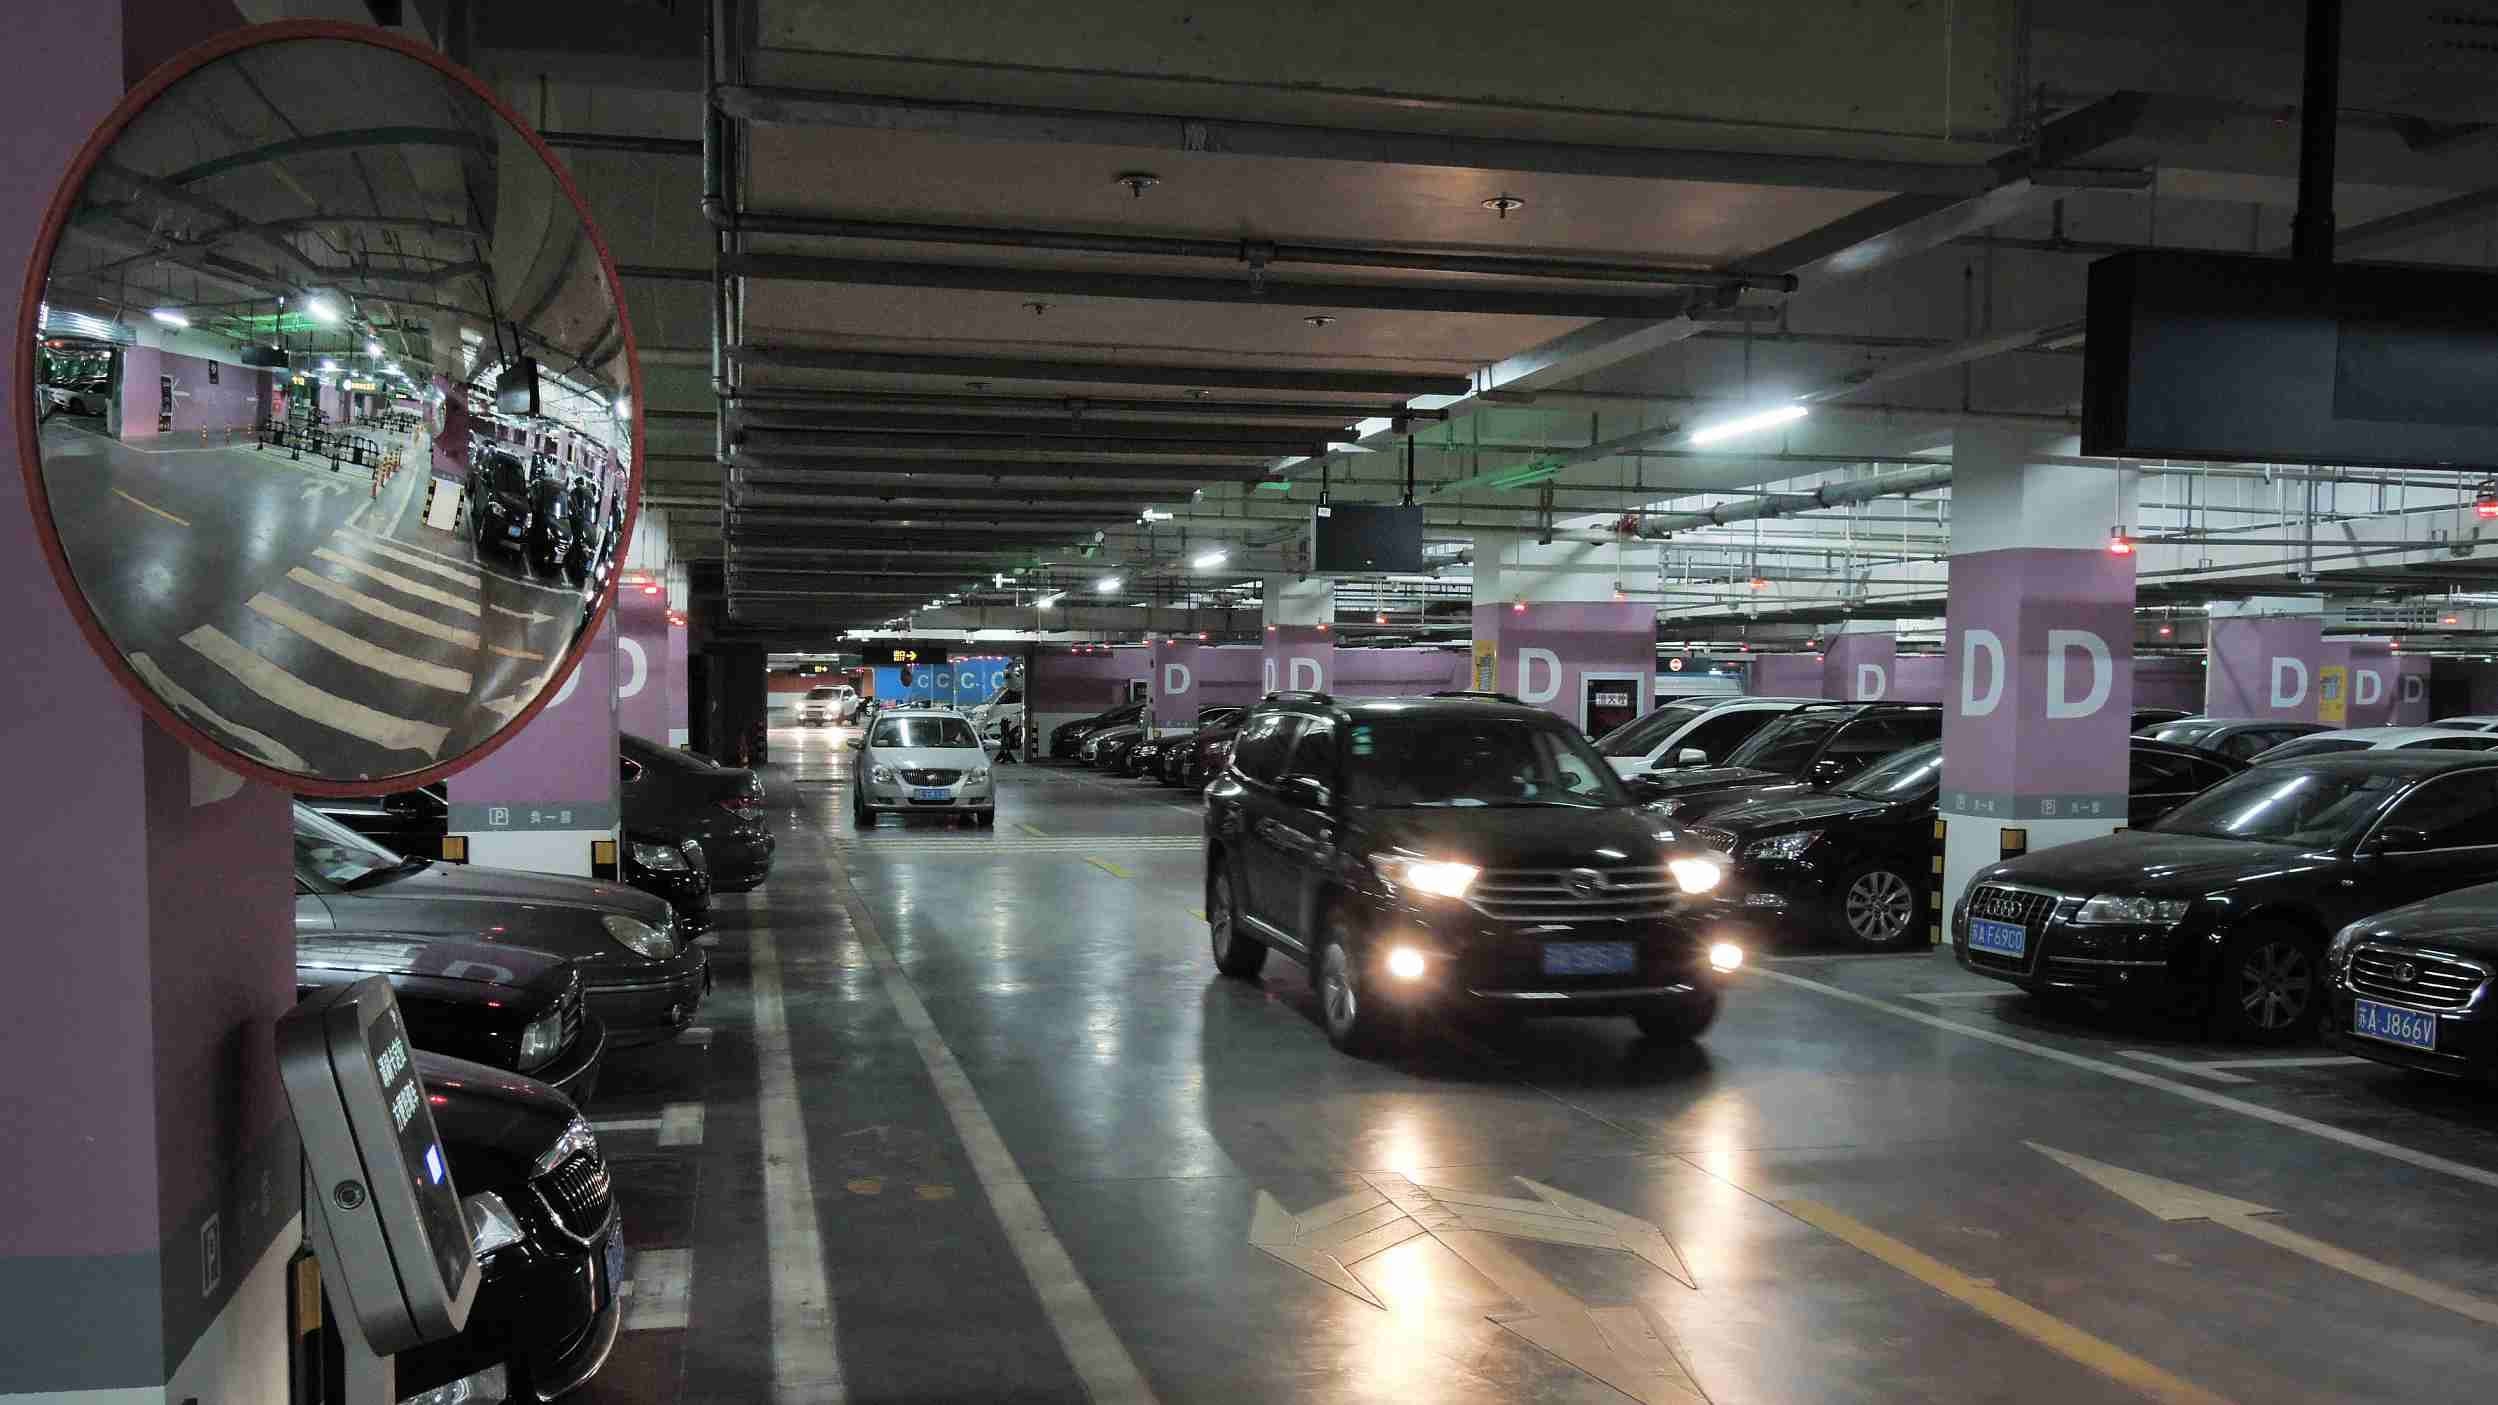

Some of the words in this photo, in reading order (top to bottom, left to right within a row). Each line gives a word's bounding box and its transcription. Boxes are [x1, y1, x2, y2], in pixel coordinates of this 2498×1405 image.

[917, 675, 929, 688] C
[937, 673, 950, 688] C
[961, 672, 977, 689] C
[1165, 664, 1191, 695] D
[1290, 657, 1323, 693] D
[1518, 648, 1562, 704] D
[1857, 664, 1886, 701] D
[1962, 630, 2005, 717] D
[2046, 630, 2113, 719] D
[2271, 656, 2308, 708] D
[2355, 670, 2382, 705] D
[2403, 676, 2424, 704] D
